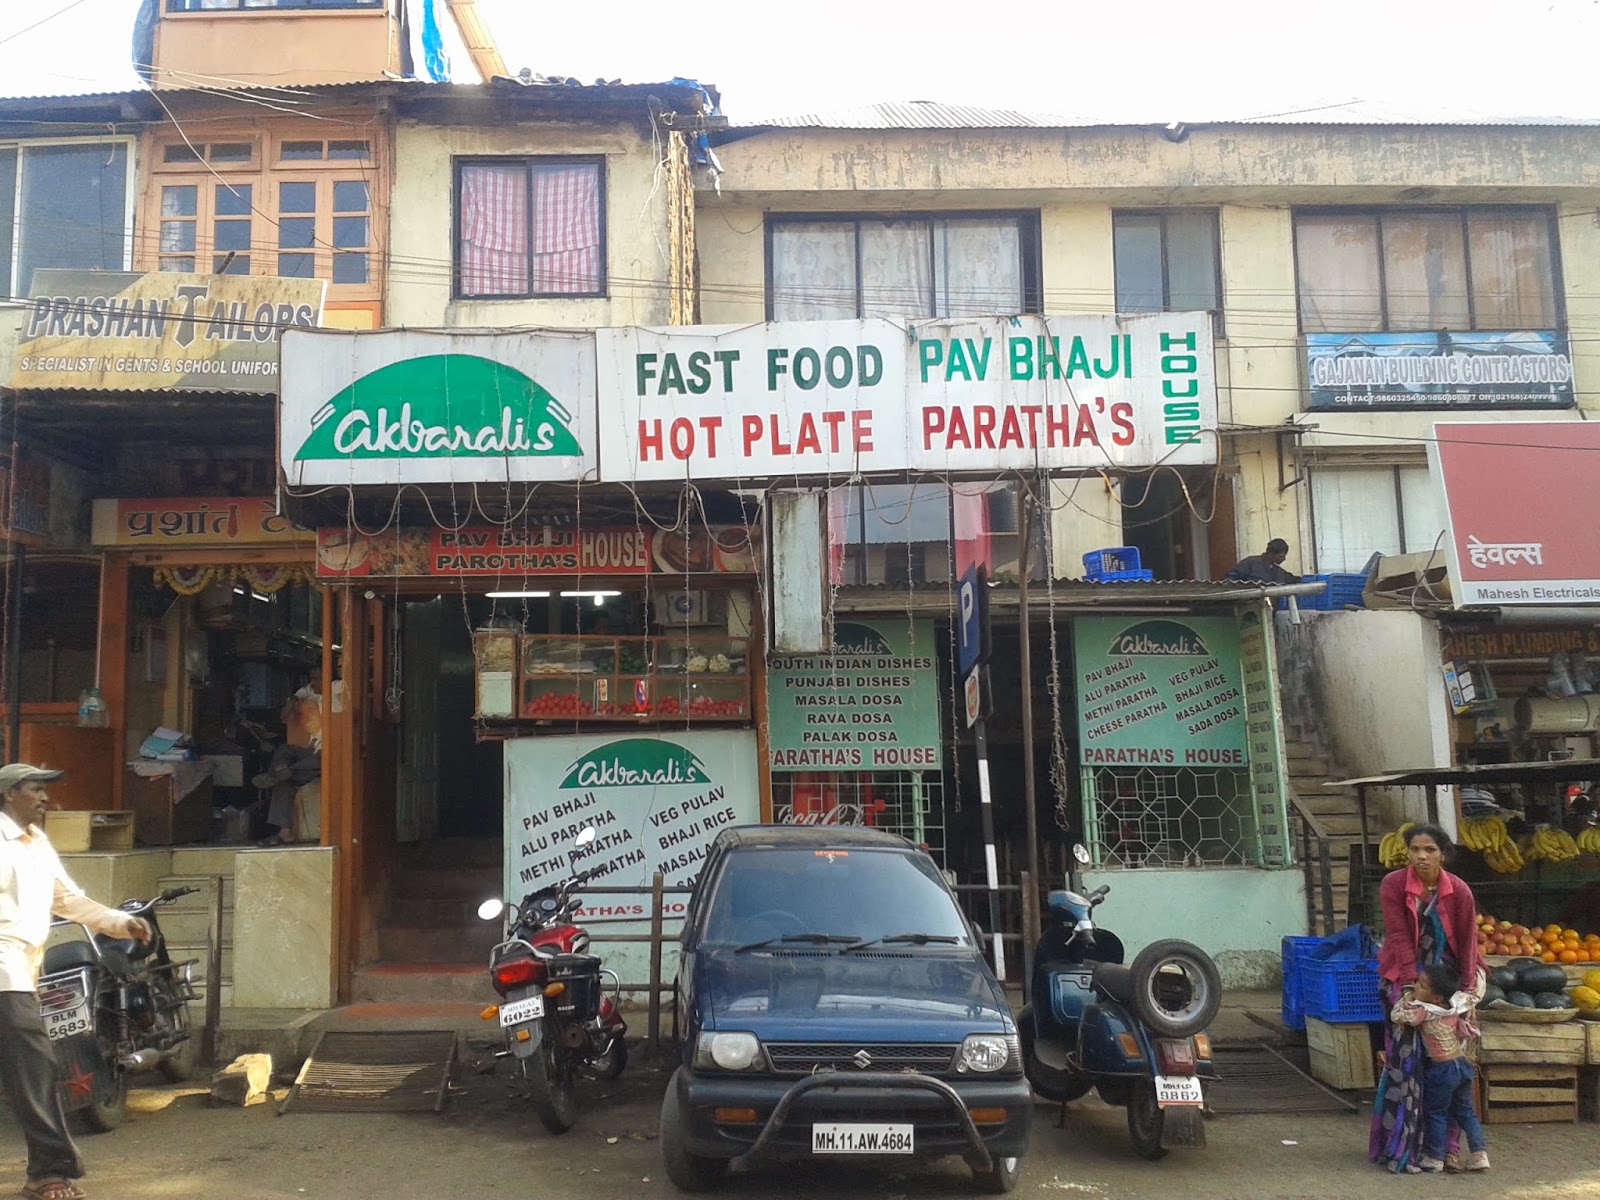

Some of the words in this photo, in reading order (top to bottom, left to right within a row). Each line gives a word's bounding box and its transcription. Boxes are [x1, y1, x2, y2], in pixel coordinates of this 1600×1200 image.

[27, 296, 169, 338] PRASHAN
[20, 356, 95, 371] SPECIALIST
[98, 357, 112, 372] IN
[115, 357, 158, 372] GENTS
[161, 359, 172, 373] &
[175, 359, 227, 374] SCHOOL
[636, 350, 740, 395] FAST
[767, 345, 883, 391] FOOD
[919, 337, 992, 382] PAV
[1008, 334, 1132, 381] BHAJI
[1314, 357, 1386, 386] GAJANAN
[1388, 356, 1458, 385] BUILDING
[1462, 355, 1569, 383] CONTRACTORS
[1159, 331, 1201, 444] HOUSE
[638, 416, 722, 461] HOT
[742, 410, 873, 457] PLATE
[922, 397, 1135, 450] PARATHA'S
[440, 532, 488, 547] PAV
[497, 532, 574, 547] BHAJI
[582, 531, 646, 568] HOUSE
[1467, 535, 1543, 569] हेवल्स
[436, 553, 577, 570] PAROTHA'S
[1477, 588, 1529, 600] Mahesh
[1532, 586, 1600, 600] Electricals
[961, 581, 973, 647] P
[820, 658, 872, 669] INDIAN
[877, 658, 931, 669] DISHES
[1085, 668, 1103, 684] PAV
[1104, 658, 1134, 677] BHAJI
[1168, 670, 1189, 687] VEG
[1190, 657, 1220, 678] PULAV
[785, 676, 850, 687] PUNJABI
[856, 676, 910, 687] DISHES
[1084, 690, 1103, 704] ALU
[1104, 671, 1148, 694] PARATHA
[1174, 685, 1204, 704] BHAJI
[1206, 673, 1227, 692] RICE
[795, 695, 856, 706] MASALA
[861, 694, 902, 705] DOSA
[1084, 703, 1115, 723] METHI
[1116, 685, 1159, 709] PARATHA
[1174, 701, 1213, 724] MASALA
[1214, 687, 1240, 707] DOSA
[807, 713, 846, 724] RAVA
[851, 713, 892, 723] DOSA
[1087, 719, 1125, 740] CHEESE
[1125, 700, 1168, 726] PARATHA
[1187, 718, 1214, 736] SADA
[1214, 705, 1241, 725] DOSA
[803, 732, 852, 742] PALAK
[857, 731, 897, 742] DOSA
[771, 748, 861, 766] ARATHA'S
[873, 747, 935, 765] HOUSE
[1083, 747, 1174, 764] PARATHA'S
[1185, 747, 1242, 764] HOUSE
[522, 809, 549, 831] PAV
[552, 791, 596, 819] BHAJI
[649, 807, 679, 828] VEG
[681, 785, 725, 815] PULAV
[520, 836, 548, 858] ALU
[551, 809, 616, 846] PARATHA
[658, 822, 701, 850] BHAJI
[703, 807, 736, 831] RICE
[520, 855, 565, 883] METHI
[590, 847, 647, 882] ARATHA
[573, 904, 643, 917] ATHA'S
[49, 1019, 86, 1038] 5683
[52, 1010, 77, 1024] BLM
[503, 1005, 541, 1024] 6022
[815, 1132, 911, 1150] MH.11.AW.4684
